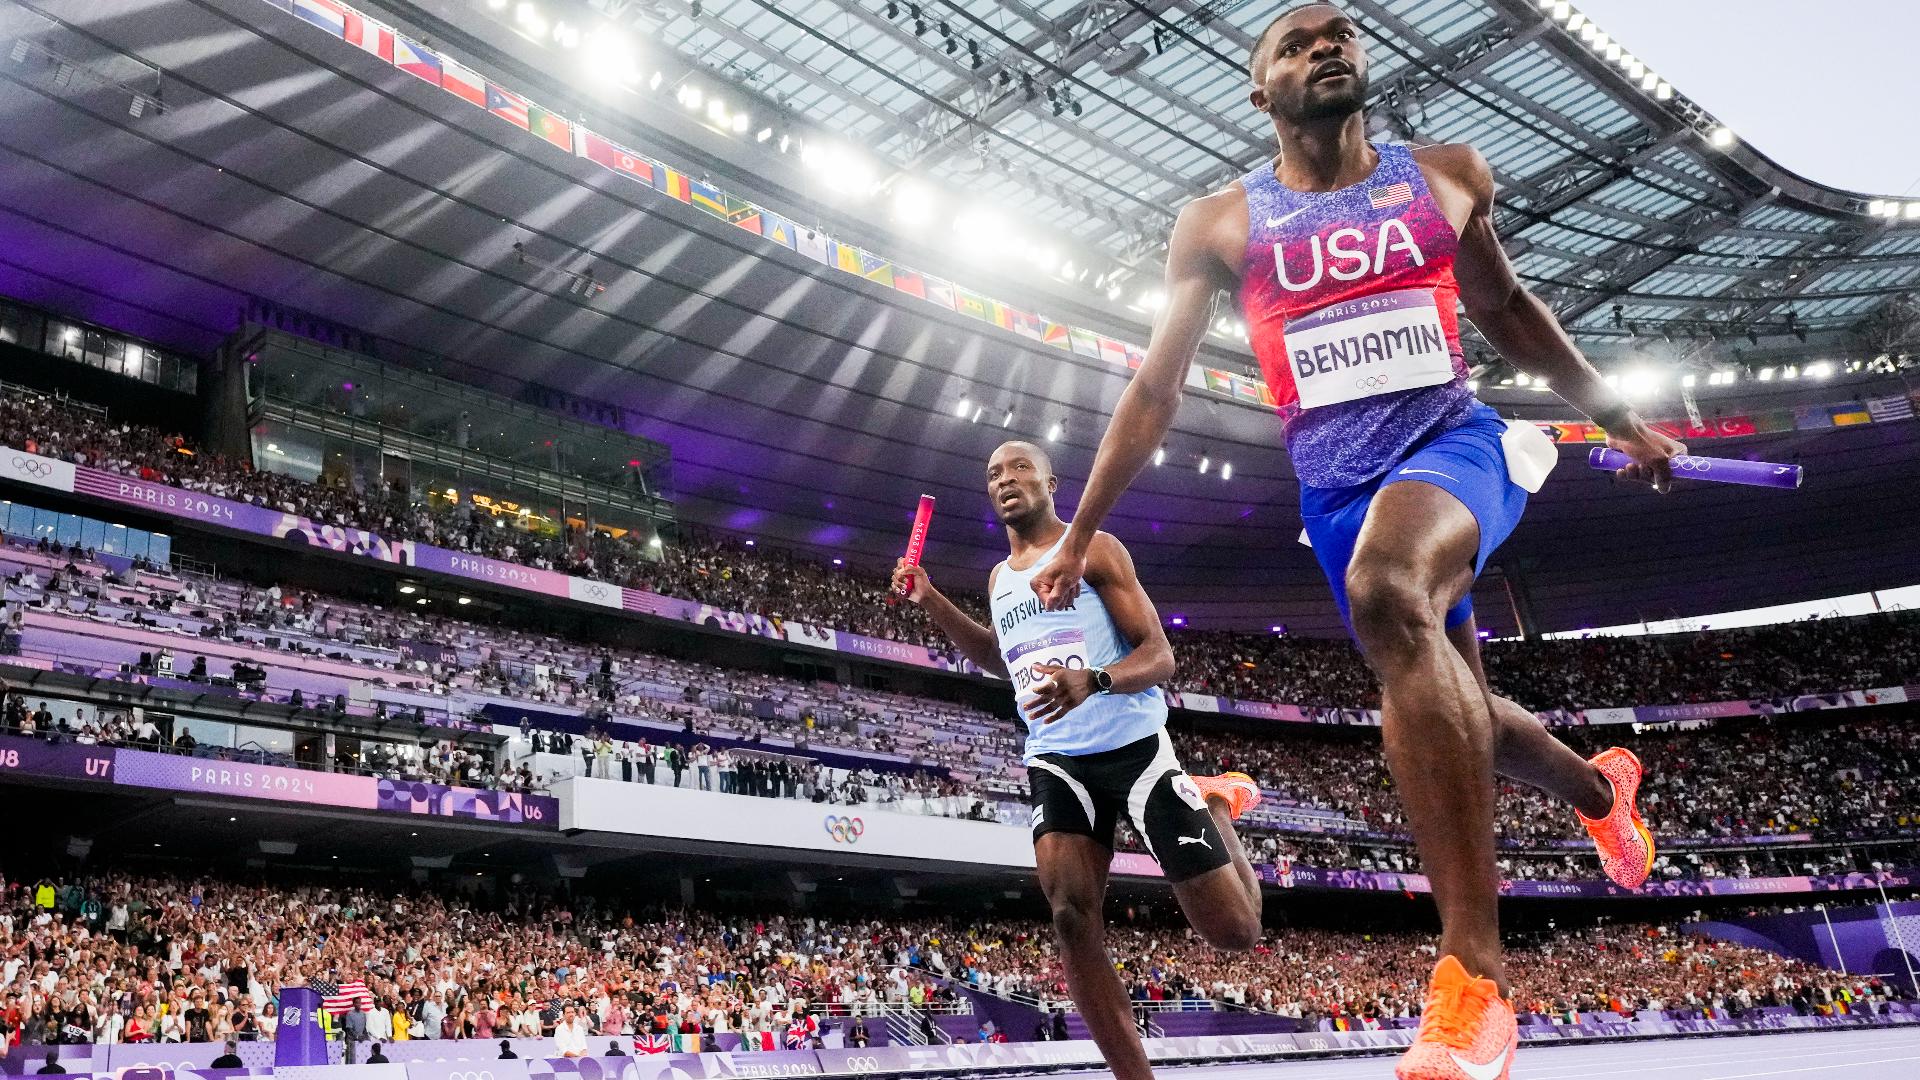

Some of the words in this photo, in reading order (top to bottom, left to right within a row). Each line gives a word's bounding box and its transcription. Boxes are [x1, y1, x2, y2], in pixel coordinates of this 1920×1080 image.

[1273, 218, 1425, 292] USA
[1319, 305, 1357, 321] PARIS
[1361, 297, 1398, 311] 2024
[1293, 323, 1443, 379] BENJAMIN
[120, 483, 176, 506] PARIS
[184, 497, 233, 520] 2024
[451, 556, 494, 576] PARIS
[500, 567, 537, 585] 2024
[1000, 597, 1077, 637] BOTSW
[440, 652, 457, 664] U13
[852, 639, 883, 654] PARIS
[886, 646, 913, 659] 2024
[85, 757, 111, 777] U7
[192, 766, 253, 788] PARIS
[262, 774, 314, 795] 2024
[524, 804, 543, 820] U6
[742, 1064, 780, 1078] PARIS
[783, 1063, 817, 1076] 2024
